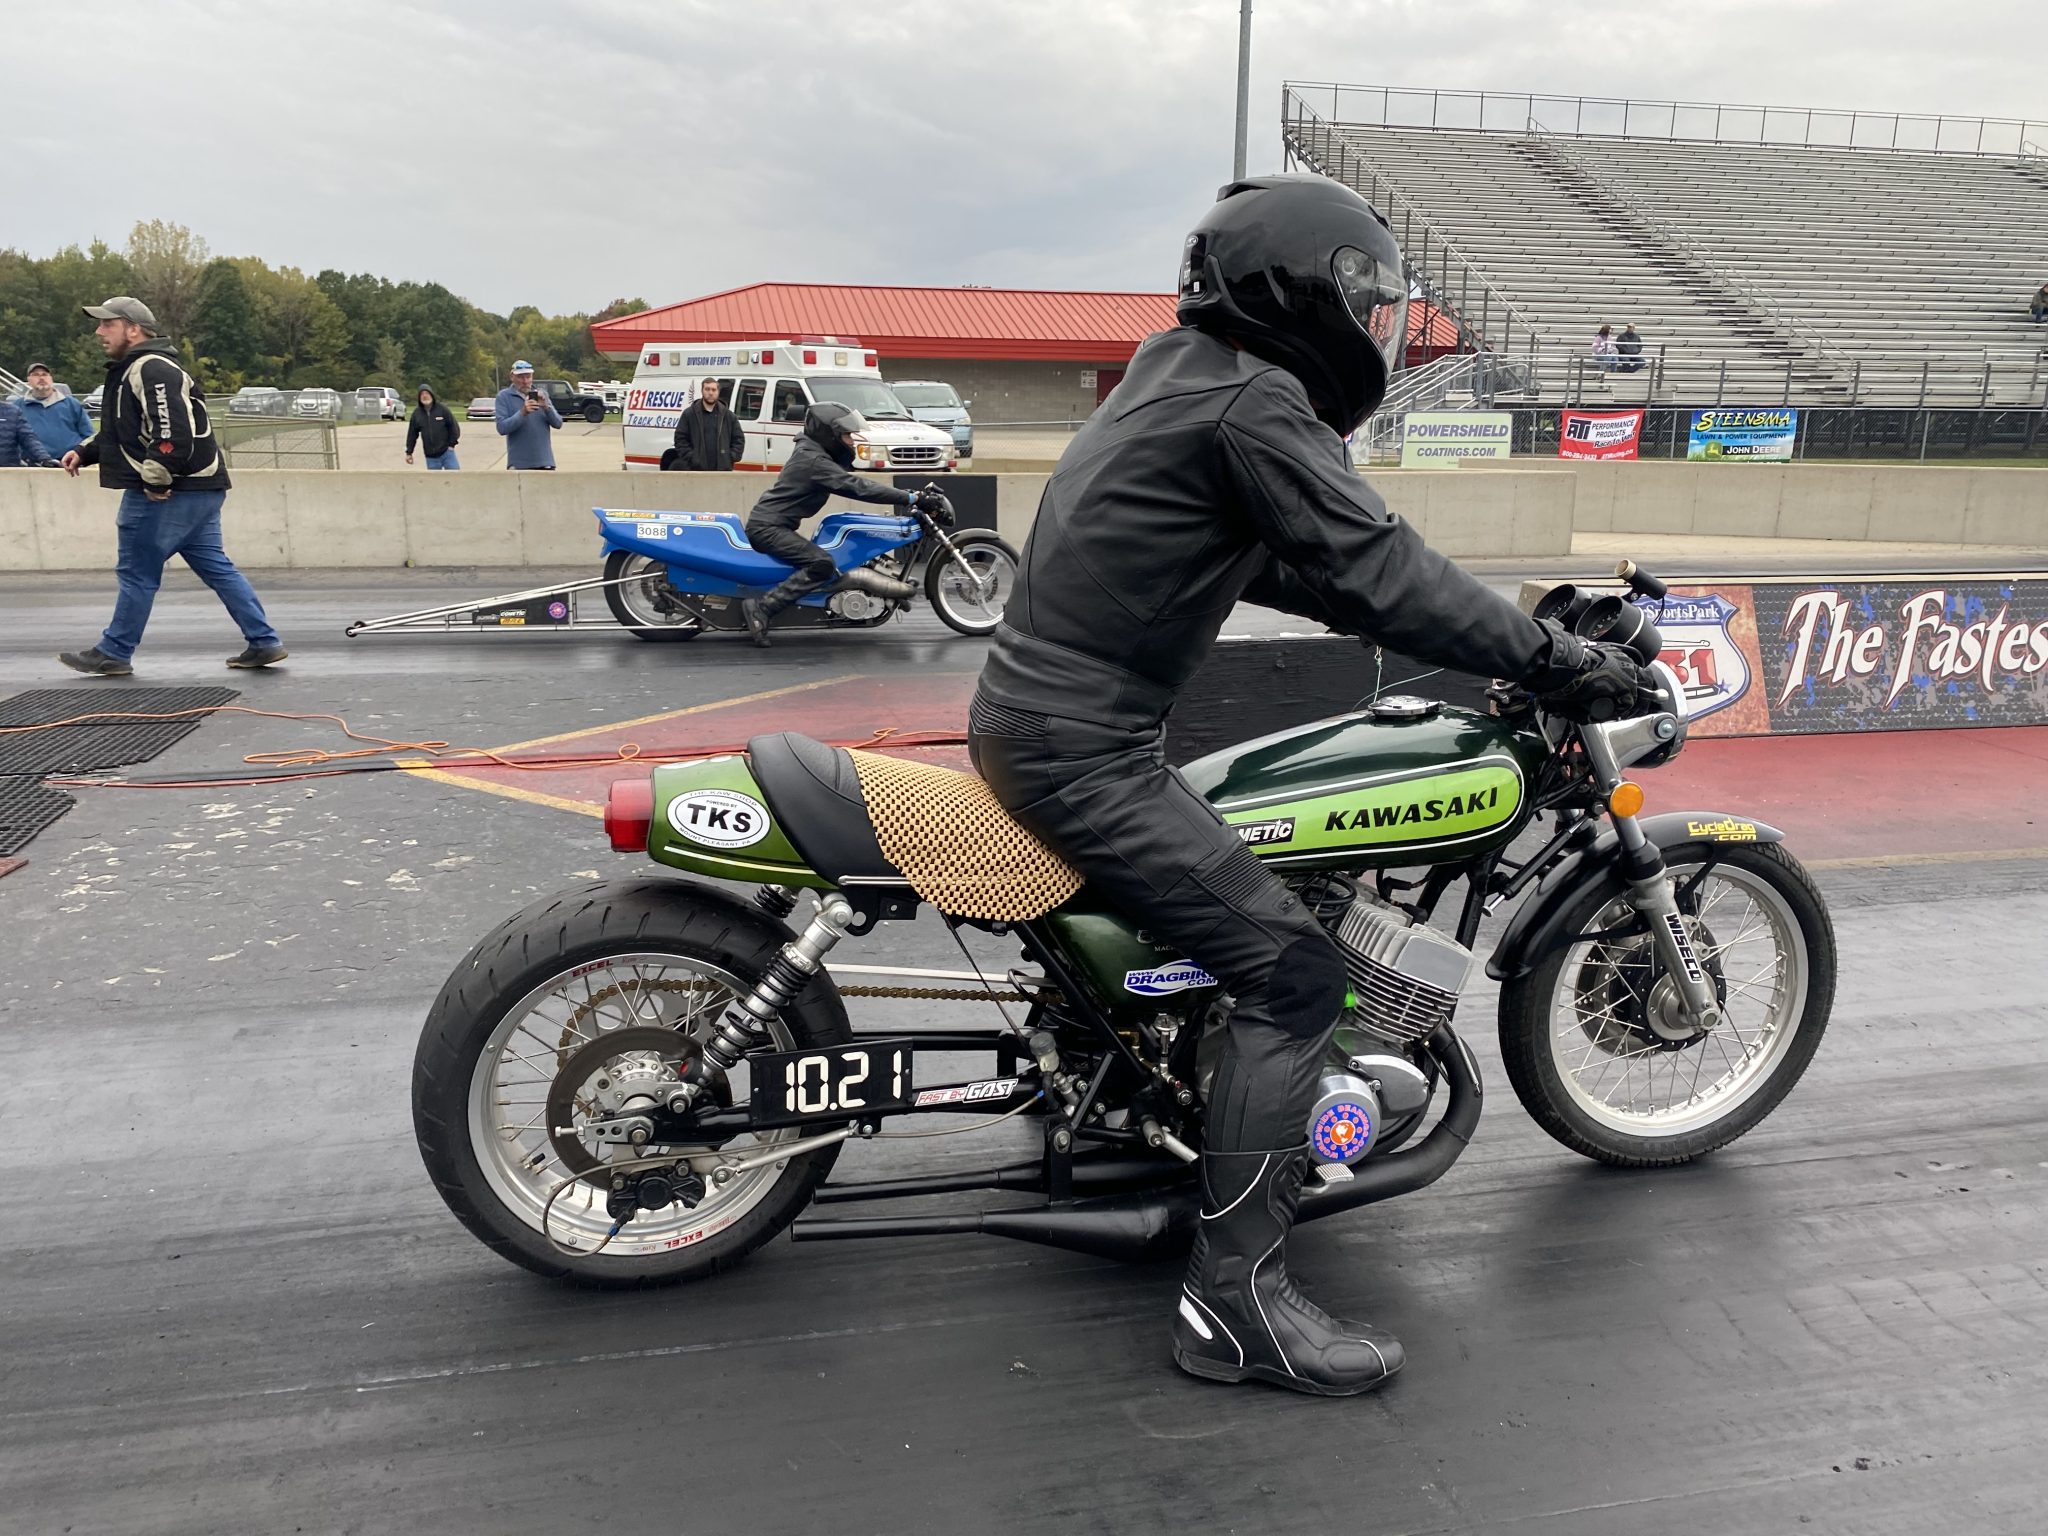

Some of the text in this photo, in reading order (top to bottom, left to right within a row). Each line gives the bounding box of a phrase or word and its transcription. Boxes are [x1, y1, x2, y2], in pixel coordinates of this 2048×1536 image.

[687, 357, 709, 366] DIVISION
[710, 357, 716, 366] OF
[628, 389, 685, 410] 131 RESCUE
[154, 383, 172, 439] SUZUKI
[628, 414, 680, 428] TRACK SERV
[1567, 418, 1593, 440] ATI
[1592, 419, 1636, 430] PERFORMANCE
[1696, 411, 1791, 432] STEENSMA
[1407, 425, 1509, 437] POWERSHIELD
[1596, 429, 1626, 438] PRODUCTS
[1417, 447, 1496, 457] COATINGS.COM
[1727, 445, 1782, 455] JOHN DEERE
[638, 526, 667, 536] 3088
[1776, 588, 2048, 710] The Fastes
[1656, 649, 1718, 686] 31
[706, 799, 730, 807] POWERED
[733, 793, 758, 807] SHOP
[687, 803, 752, 833] TKS
[1238, 787, 1497, 842] METIC KAWASAKI
[1688, 816, 1756, 836] CycleDrag
[679, 827, 702, 842] MOUNT
[702, 839, 739, 847] PLEASANT
[1665, 913, 1703, 980] WISECO
[572, 959, 614, 977] EXCEL
[1127, 970, 1210, 986] DRAGBIK
[785, 1049, 902, 1114] 10.21
[918, 1080, 1016, 1104] FAST BY GAST
[664, 1230, 703, 1249] EXCEL
